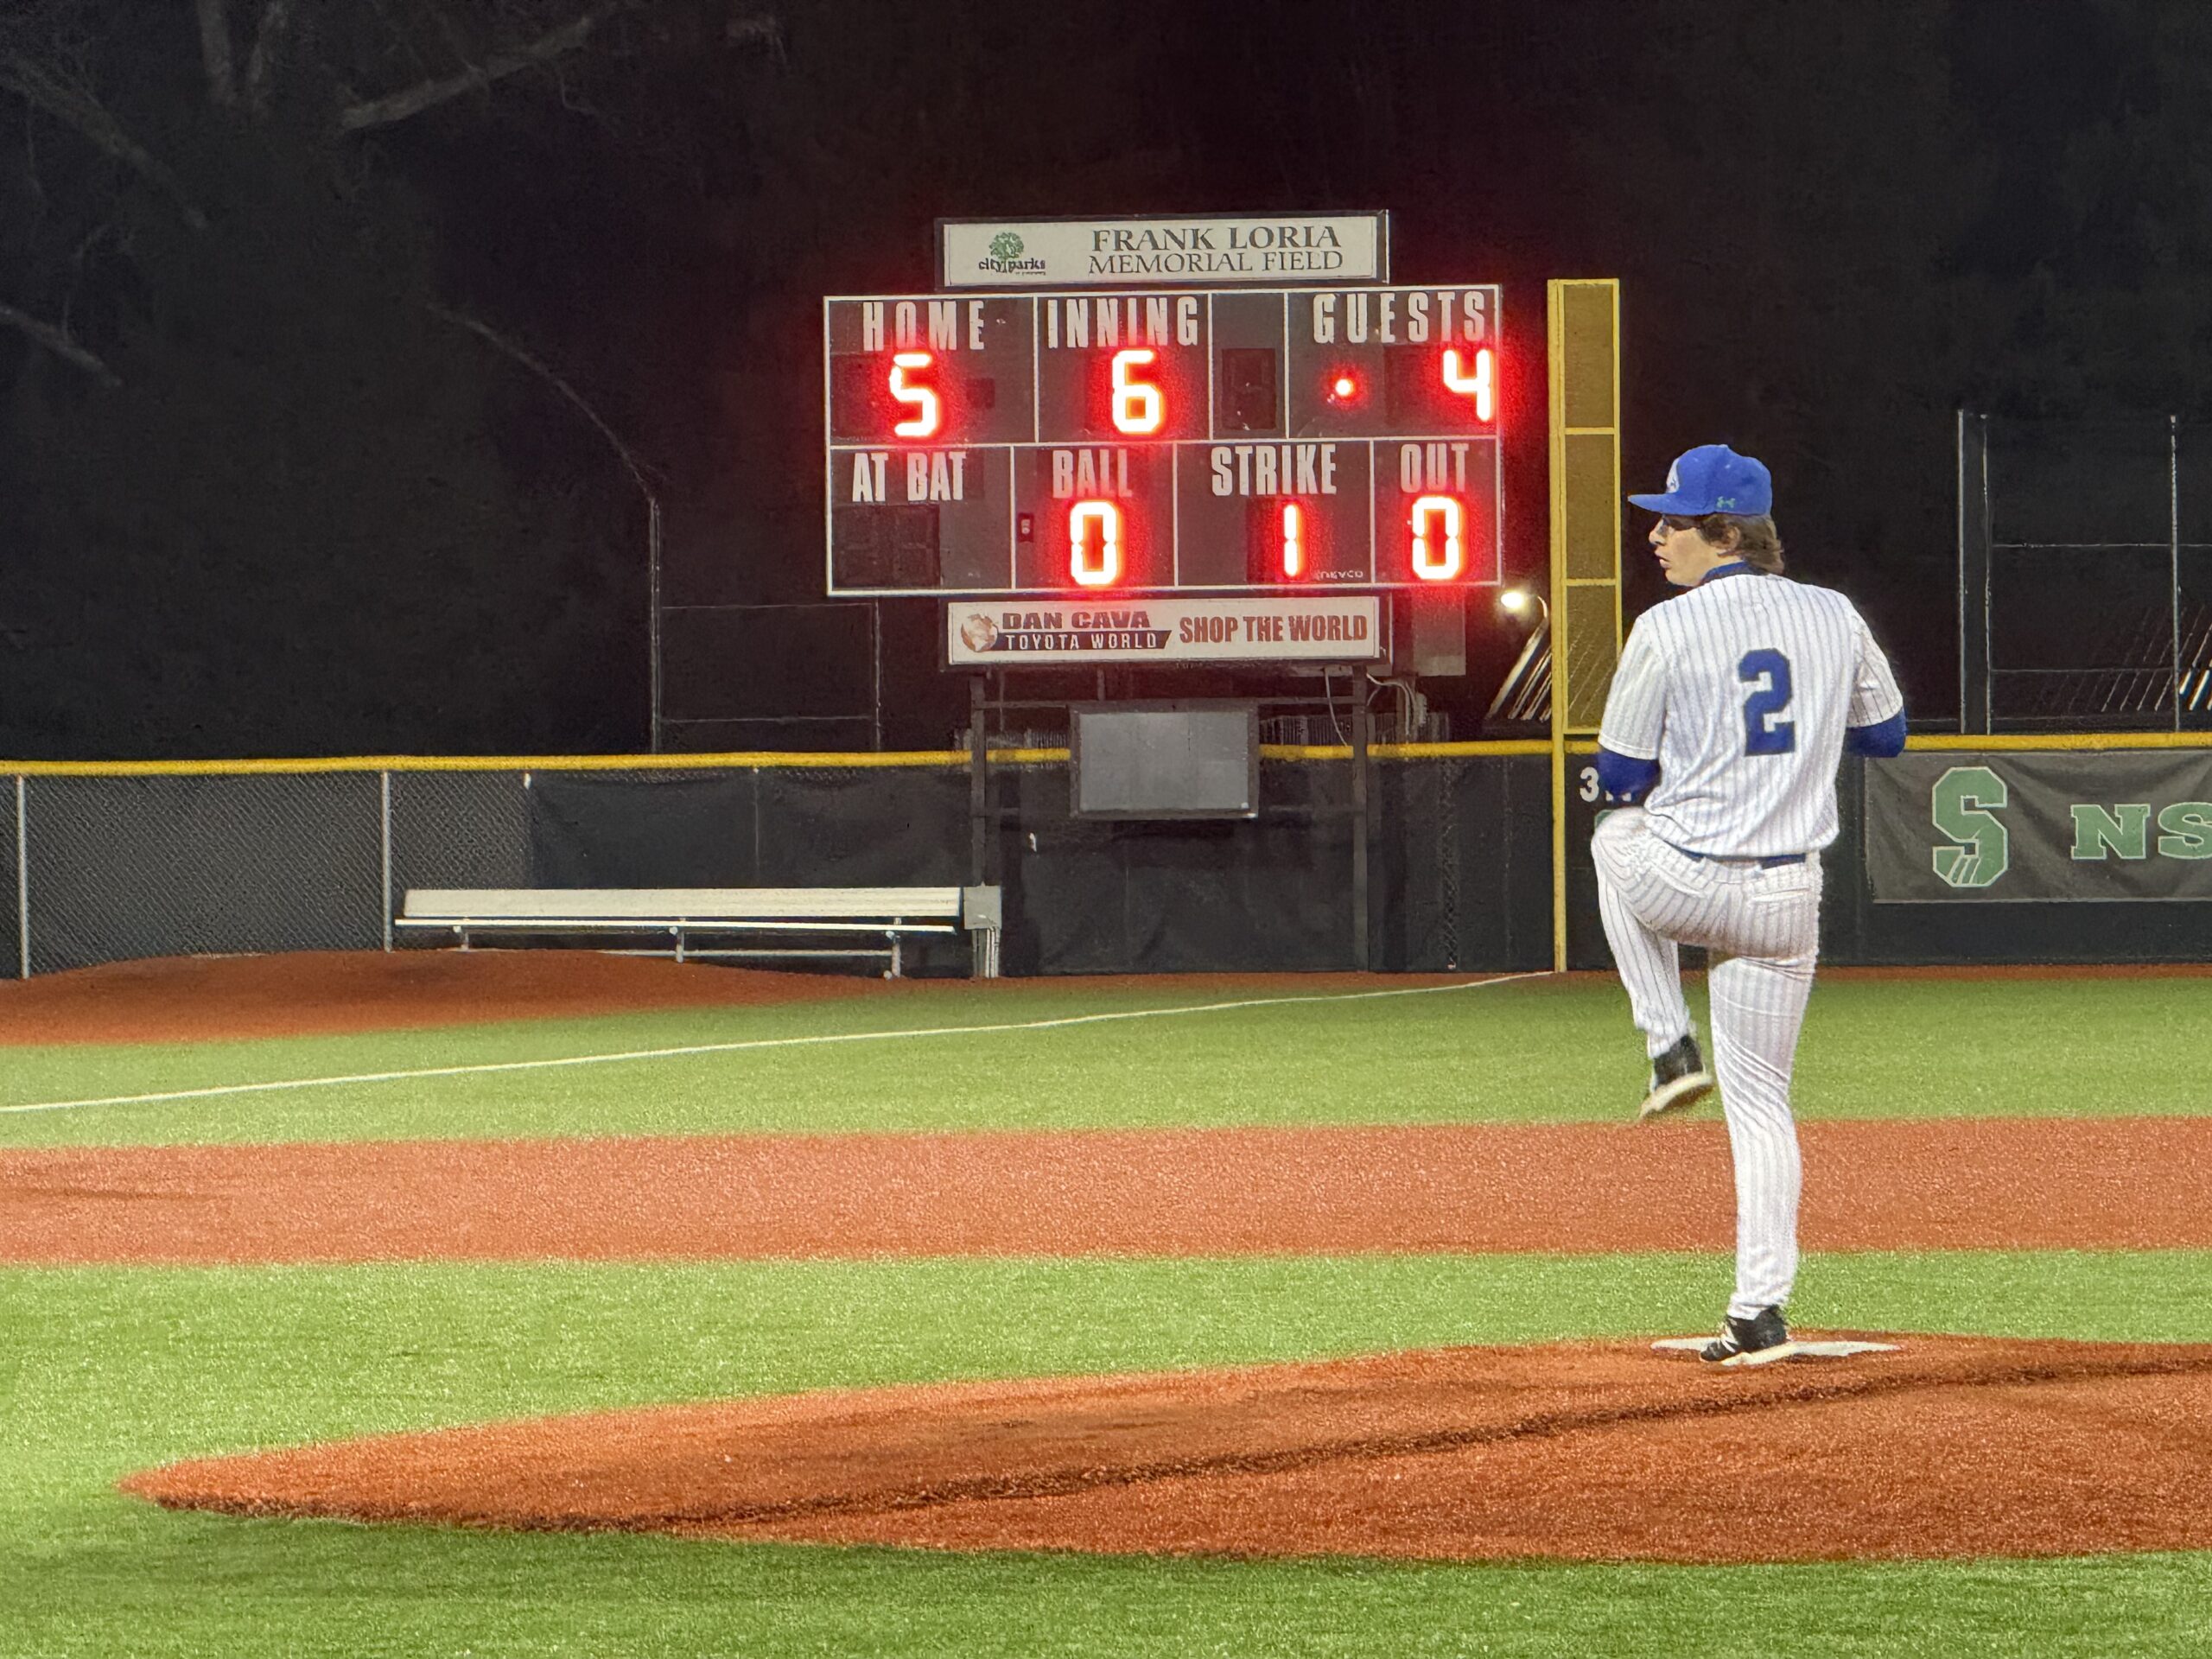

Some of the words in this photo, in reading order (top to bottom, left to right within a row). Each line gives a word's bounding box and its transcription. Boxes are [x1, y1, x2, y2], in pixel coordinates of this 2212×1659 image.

[1089, 251, 1253, 275] MEMORIAL
[1262, 250, 1344, 271] FIELD
[1091, 226, 1213, 251] FRANK
[1227, 225, 1341, 249] LORIA
[1008, 257, 1046, 273] parks
[863, 300, 986, 351] HOME
[1048, 295, 1199, 347] INNING
[1313, 291, 1485, 345] GUESTS
[890, 352, 938, 438] 5
[1111, 349, 1160, 434] 6
[1443, 348, 1492, 422] 4
[852, 451, 889, 502] AT
[907, 450, 967, 501] BAT
[1052, 448, 1133, 498] BALL
[1211, 442, 1337, 496] STRIKE
[1401, 443, 1470, 493] OUT
[1070, 500, 1117, 586] 0
[1283, 504, 1299, 577] 1
[1412, 496, 1460, 580] 0
[1002, 612, 1064, 629] DAN
[1071, 611, 1151, 629] CAVA
[1007, 634, 1080, 651] TOYOTA
[1090, 632, 1157, 649] WORLD
[1179, 615, 1238, 644] SHOP
[1243, 615, 1283, 643] THE
[1288, 614, 1368, 642] WORLD
[1737, 648, 1796, 757] 2
[1932, 766, 2008, 887] S
